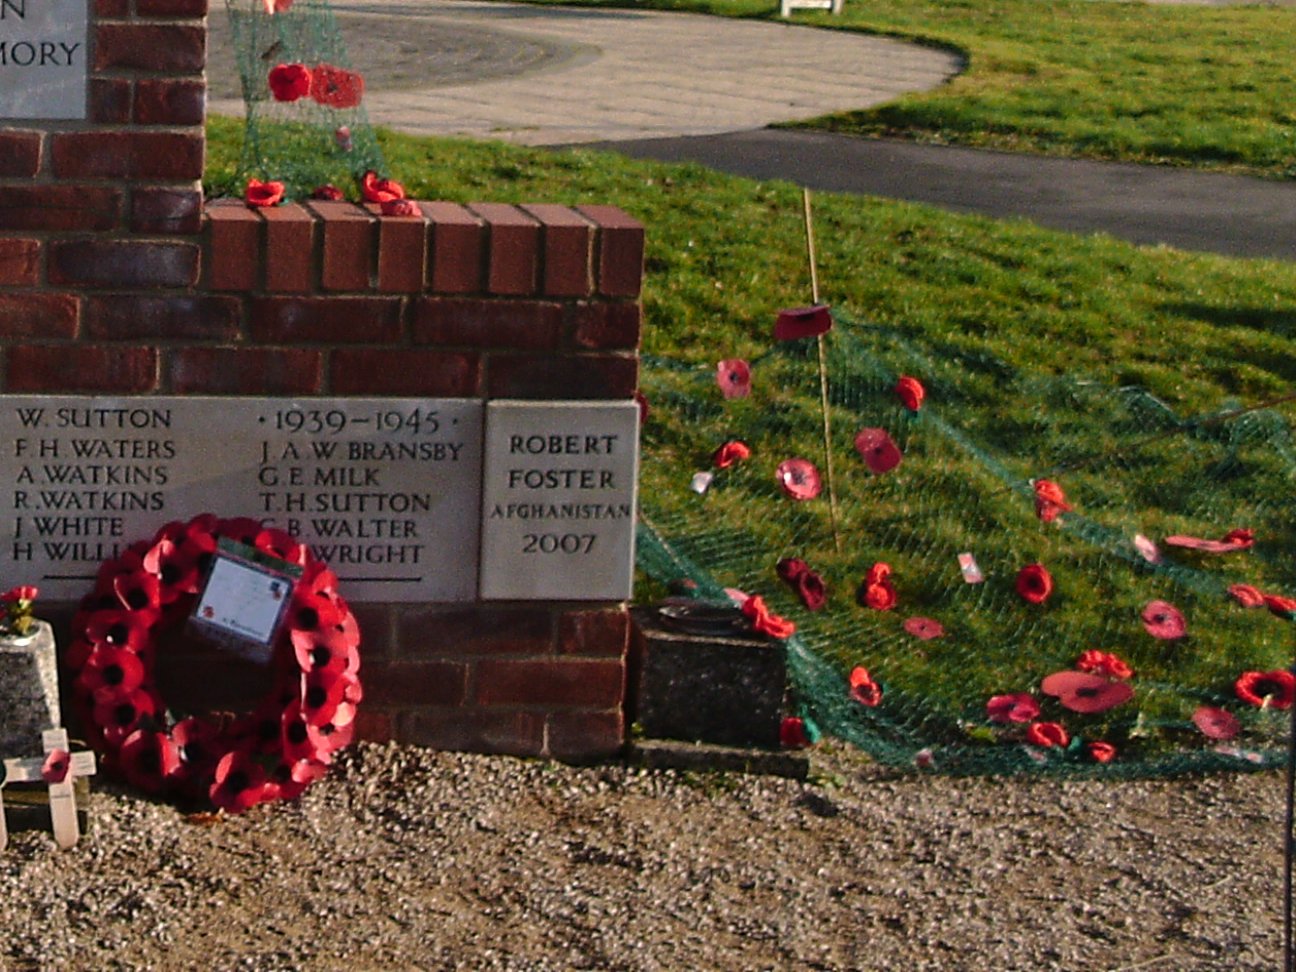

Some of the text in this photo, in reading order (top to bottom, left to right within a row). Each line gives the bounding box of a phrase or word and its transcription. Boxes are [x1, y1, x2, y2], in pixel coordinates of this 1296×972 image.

[509, 434, 619, 455] ROBERT
[508, 469, 616, 489] FOSTER
[490, 503, 631, 520] AFGHANISTAN
[33, 516, 124, 537] WHITE
[522, 532, 598, 555] 2007
[310, 544, 425, 565] WRIGHT
